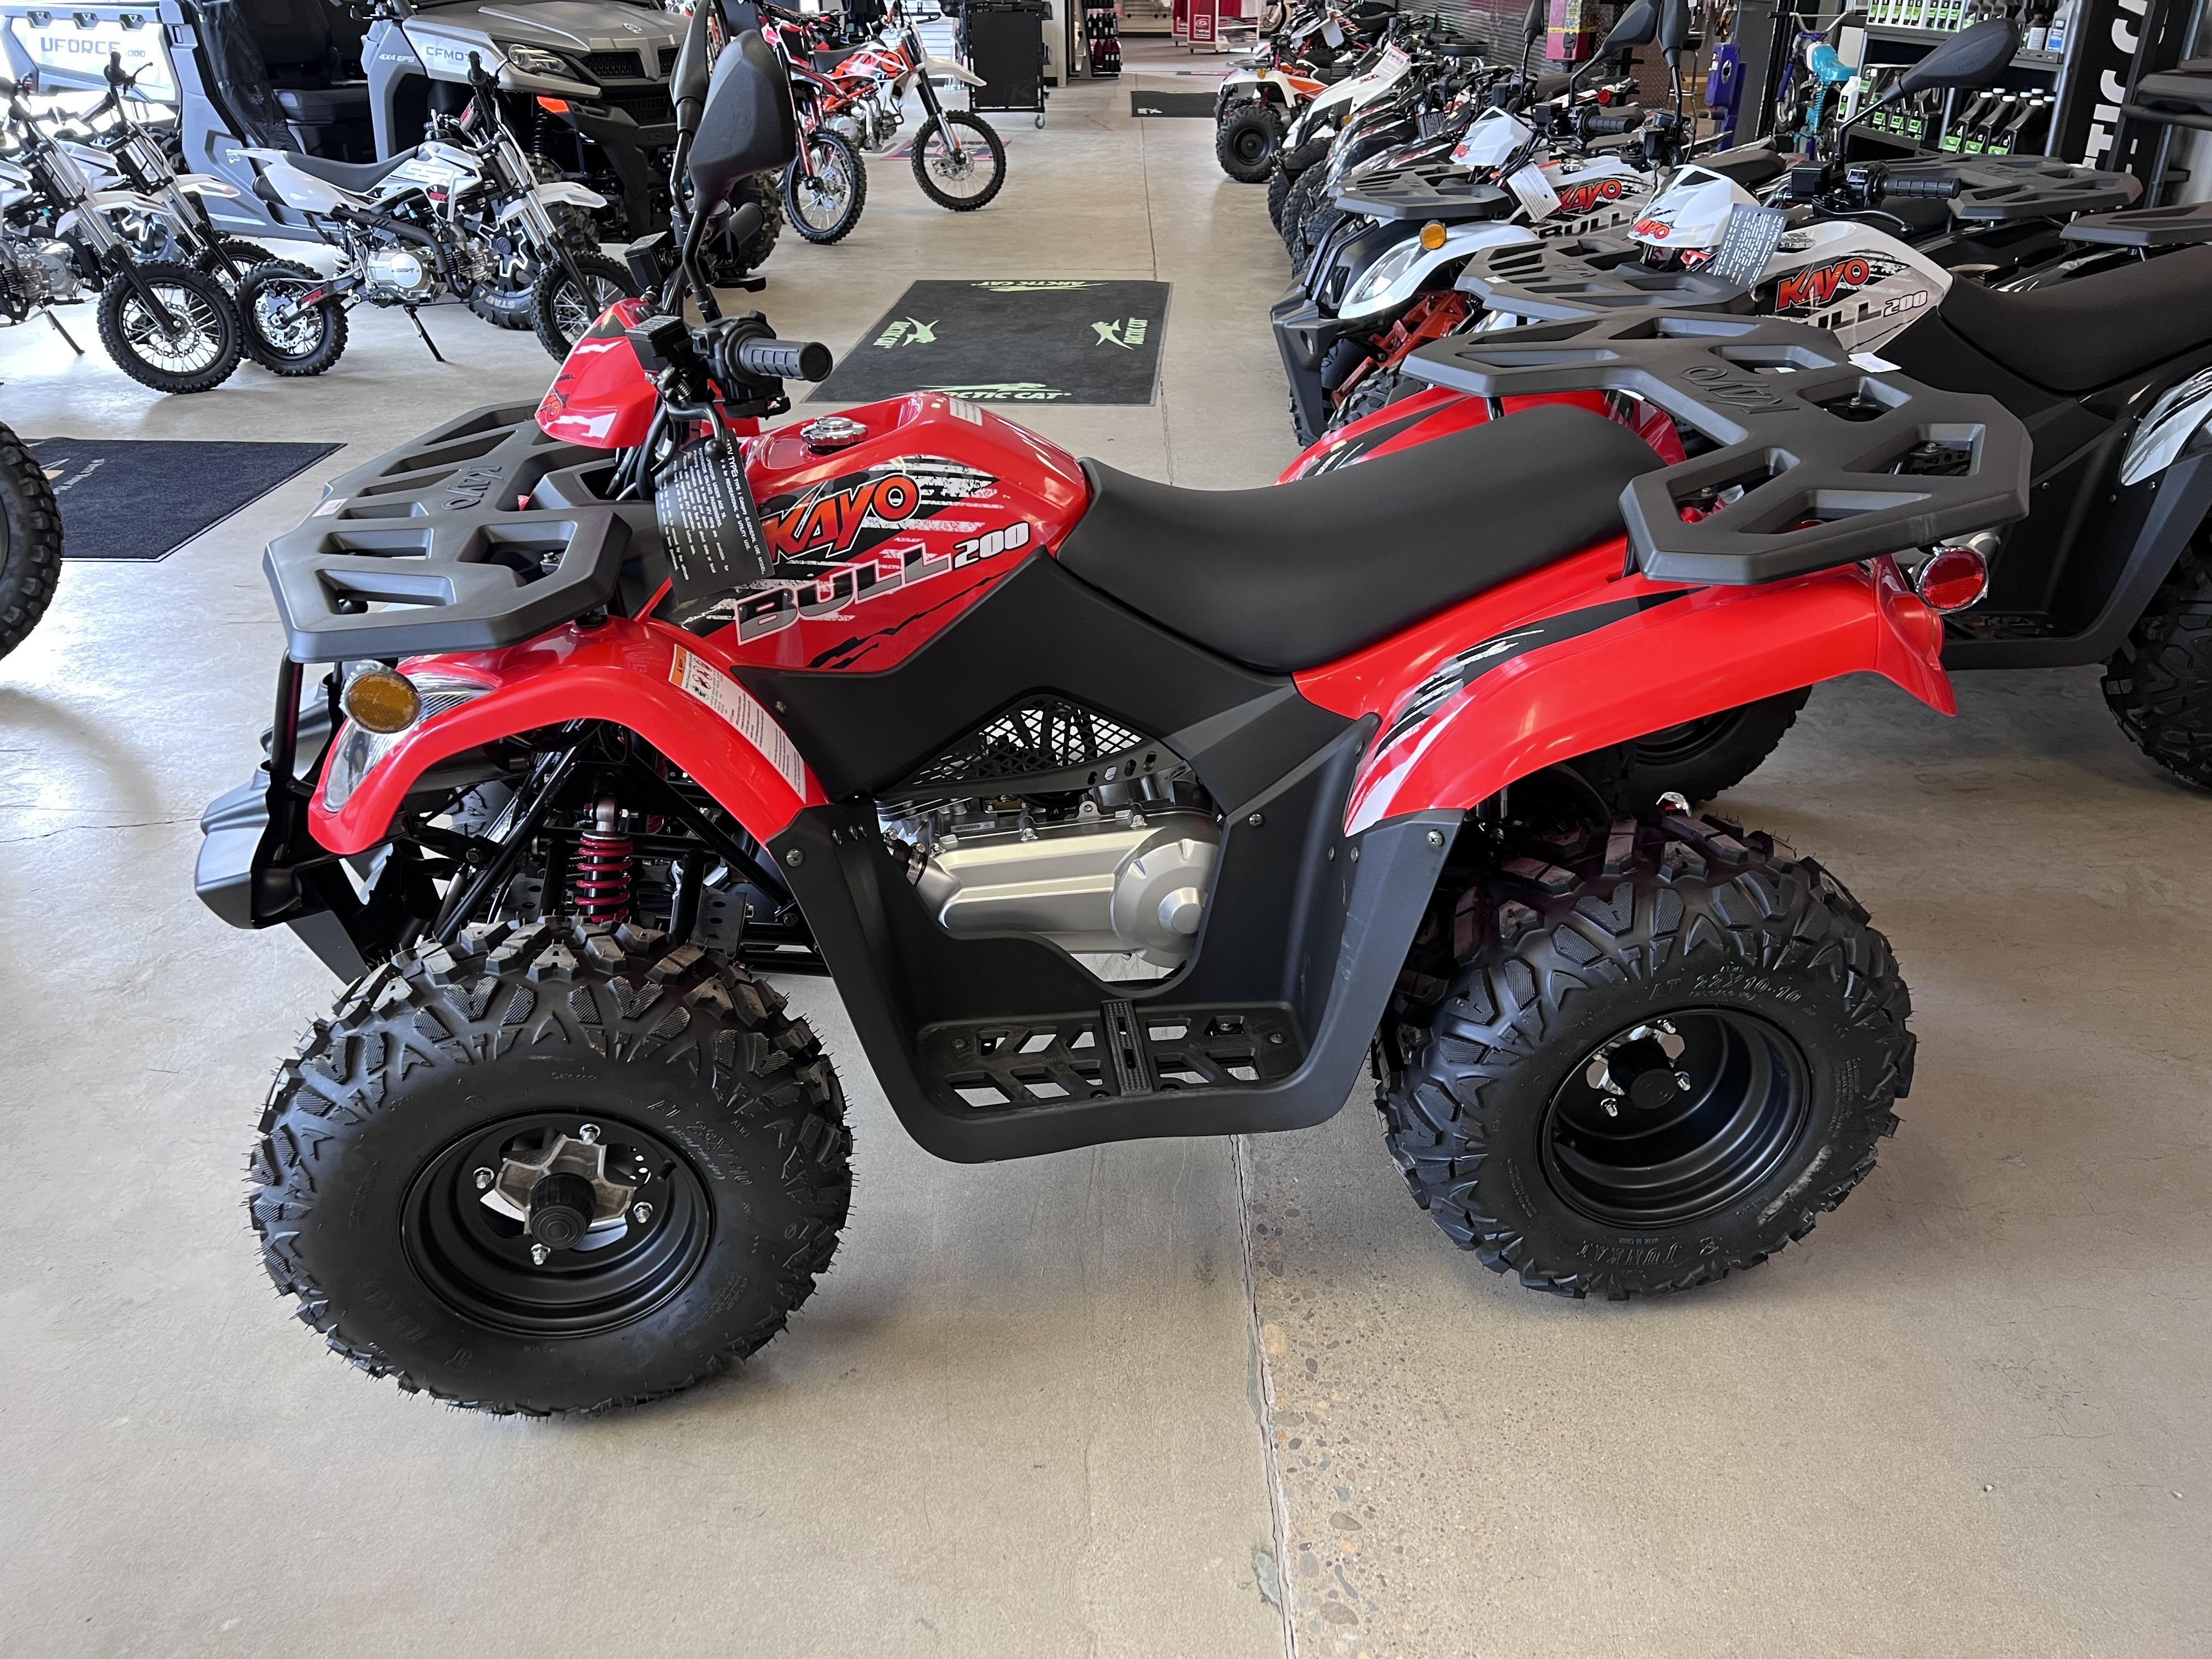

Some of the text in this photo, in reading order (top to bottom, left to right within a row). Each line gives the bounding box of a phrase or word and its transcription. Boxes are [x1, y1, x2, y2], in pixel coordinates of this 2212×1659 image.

[41, 37, 121, 54] UFORCE
[1554, 179, 1622, 216] KAYO
[1541, 212, 1632, 240] BULL
[1775, 257, 1870, 312] KAYO
[1883, 290, 1928, 318] 200
[1014, 391, 1064, 399] CAT
[441, 466, 504, 511] KAYO
[760, 472, 921, 566] KAYO
[734, 521, 1030, 645] BULL 200
[1649, 978, 1682, 1001] AT
